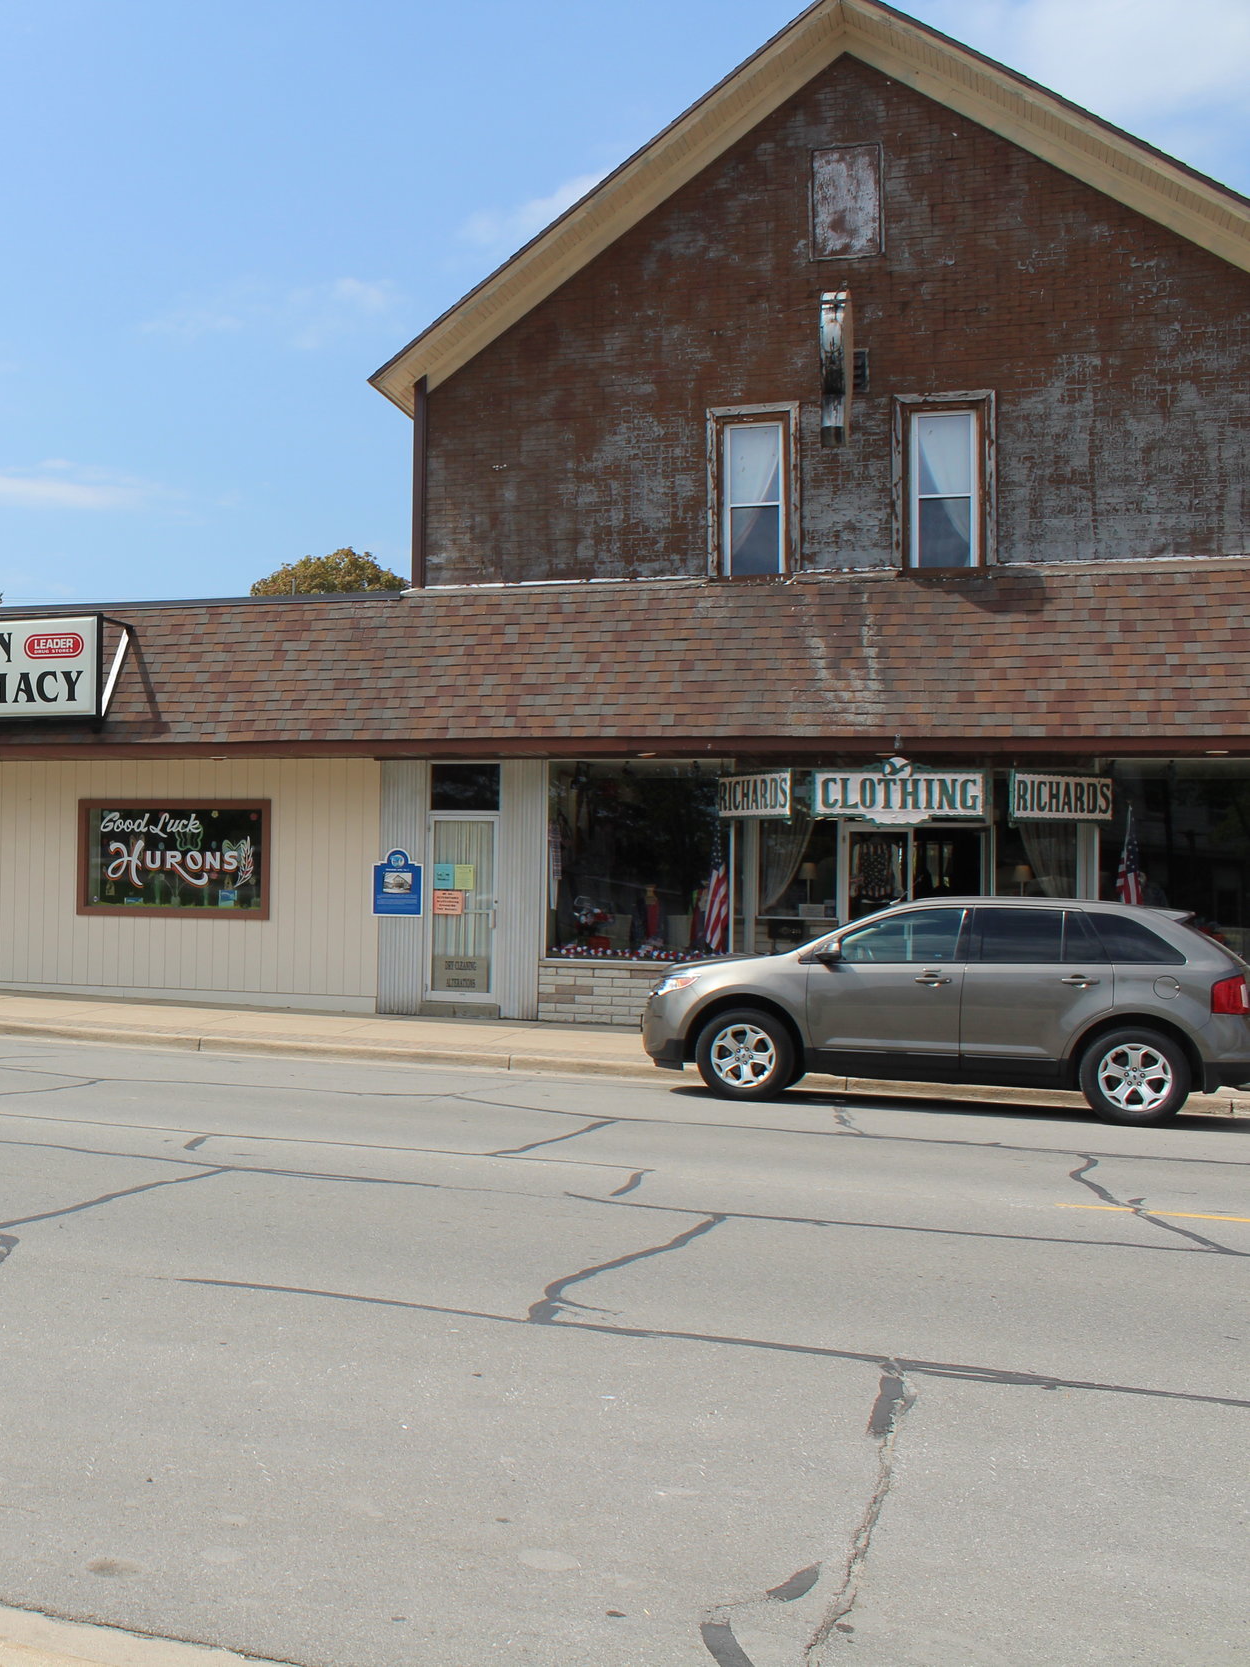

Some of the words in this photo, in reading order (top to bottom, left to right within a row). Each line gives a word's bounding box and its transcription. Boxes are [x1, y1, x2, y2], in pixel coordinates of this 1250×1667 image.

[34, 638, 74, 650] LEADER
[720, 775, 788, 812] RICHARD'S
[821, 777, 979, 811] CLOTHING
[1016, 780, 1111, 814] RICHARD'S
[100, 812, 150, 833] Good
[149, 813, 202, 838] Luck
[105, 839, 240, 889] HURONS
